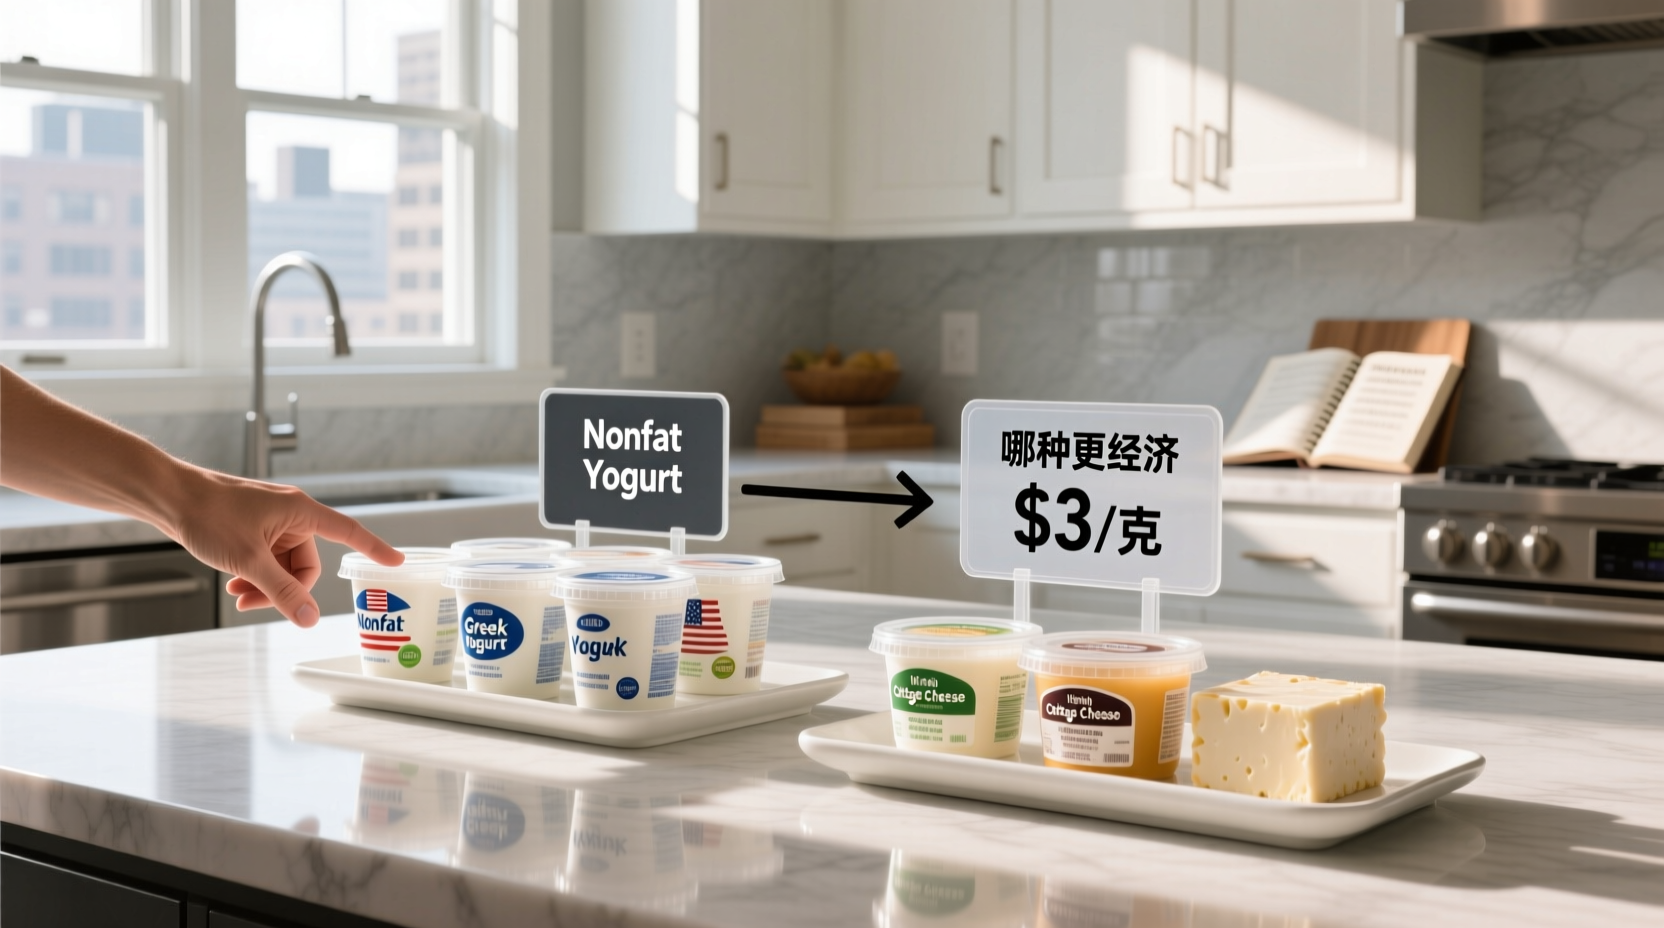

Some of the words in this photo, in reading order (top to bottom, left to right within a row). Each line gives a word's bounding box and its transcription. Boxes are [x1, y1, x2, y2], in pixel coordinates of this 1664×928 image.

[583, 418, 682, 452] Nonfat
[1001, 430, 1179, 474] 哪种更经济
[583, 459, 682, 500] Yogurt
[1014, 482, 1162, 556] $3/克
[357, 612, 405, 632] Nonfat
[464, 617, 508, 636] Greek
[572, 635, 628, 662] Yoguk
[924, 689, 966, 703] Cheese
